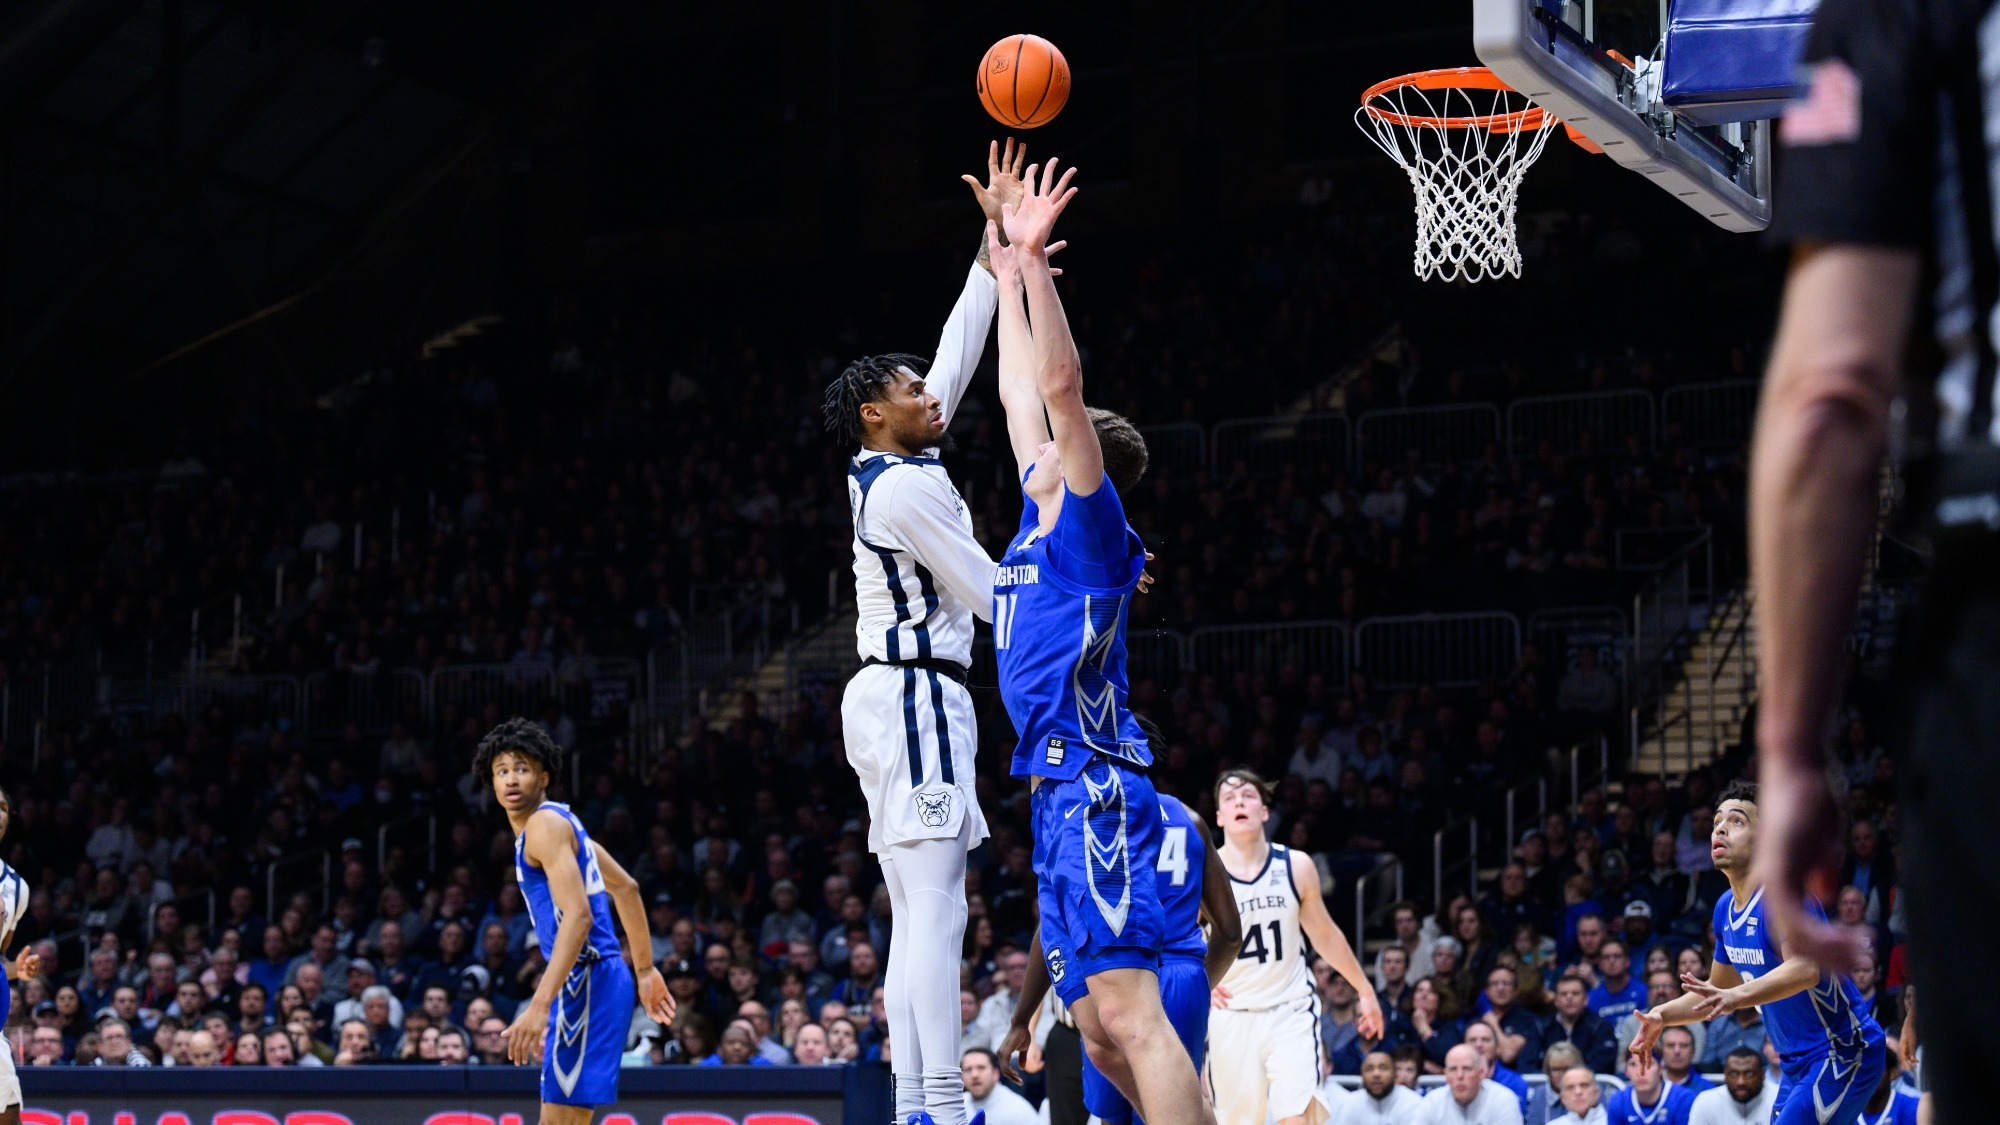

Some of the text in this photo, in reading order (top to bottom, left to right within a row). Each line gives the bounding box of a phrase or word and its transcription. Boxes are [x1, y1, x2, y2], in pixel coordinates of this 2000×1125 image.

[994, 594, 1018, 650] 11
[1050, 739, 1062, 747] 52
[1157, 826, 1189, 887] 4
[1237, 919, 1283, 965] 41
